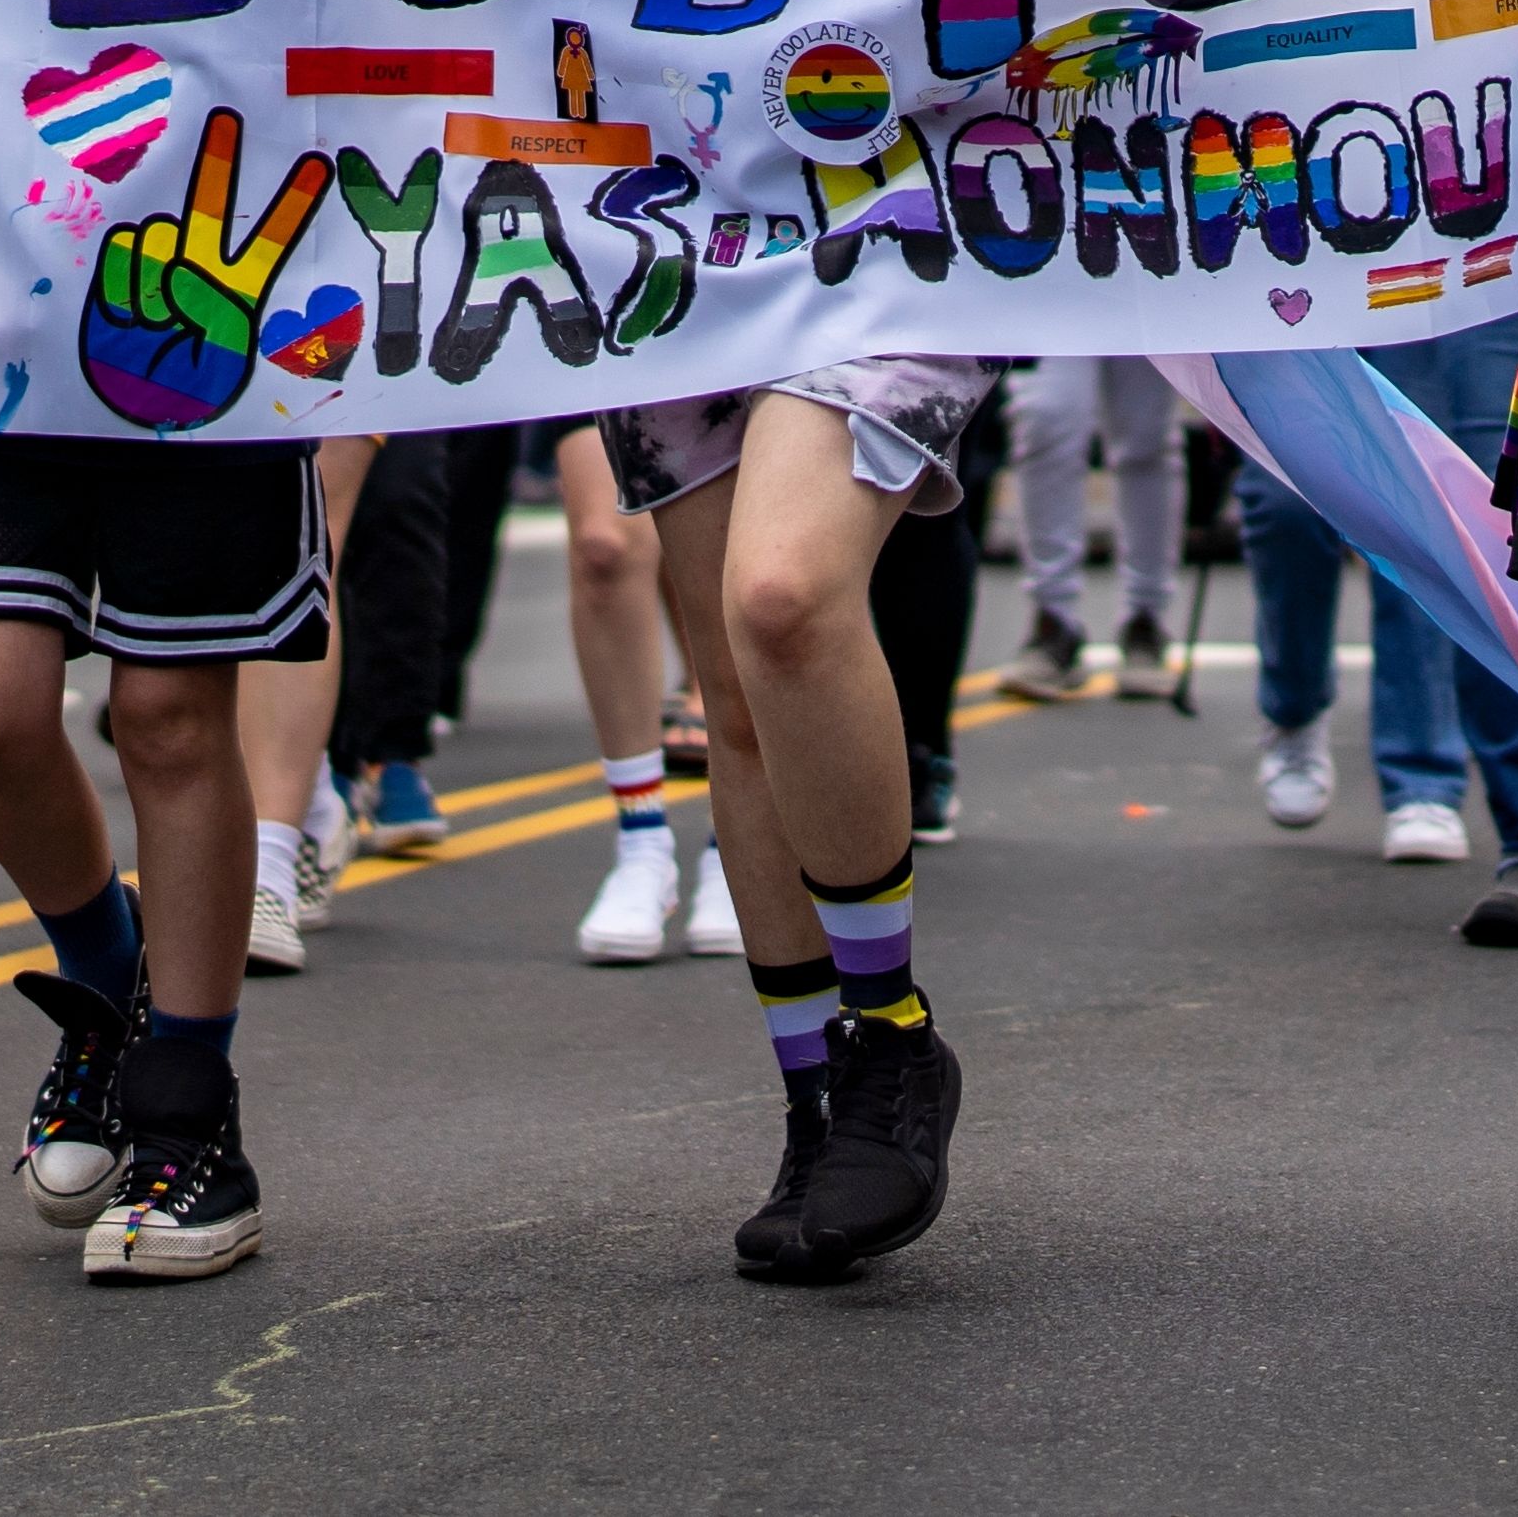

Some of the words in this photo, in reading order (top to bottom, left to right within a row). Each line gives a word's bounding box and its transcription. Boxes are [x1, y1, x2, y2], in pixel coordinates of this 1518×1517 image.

[803, 23, 857, 44] LATE
[861, 31, 883, 55] TO
[1266, 25, 1353, 48] EQUALITY
[771, 34, 804, 65] TOO
[364, 64, 411, 81] LOVE
[763, 66, 790, 130] NEVER
[510, 135, 588, 154] RESPECT
[337, 146, 701, 385] YAS
